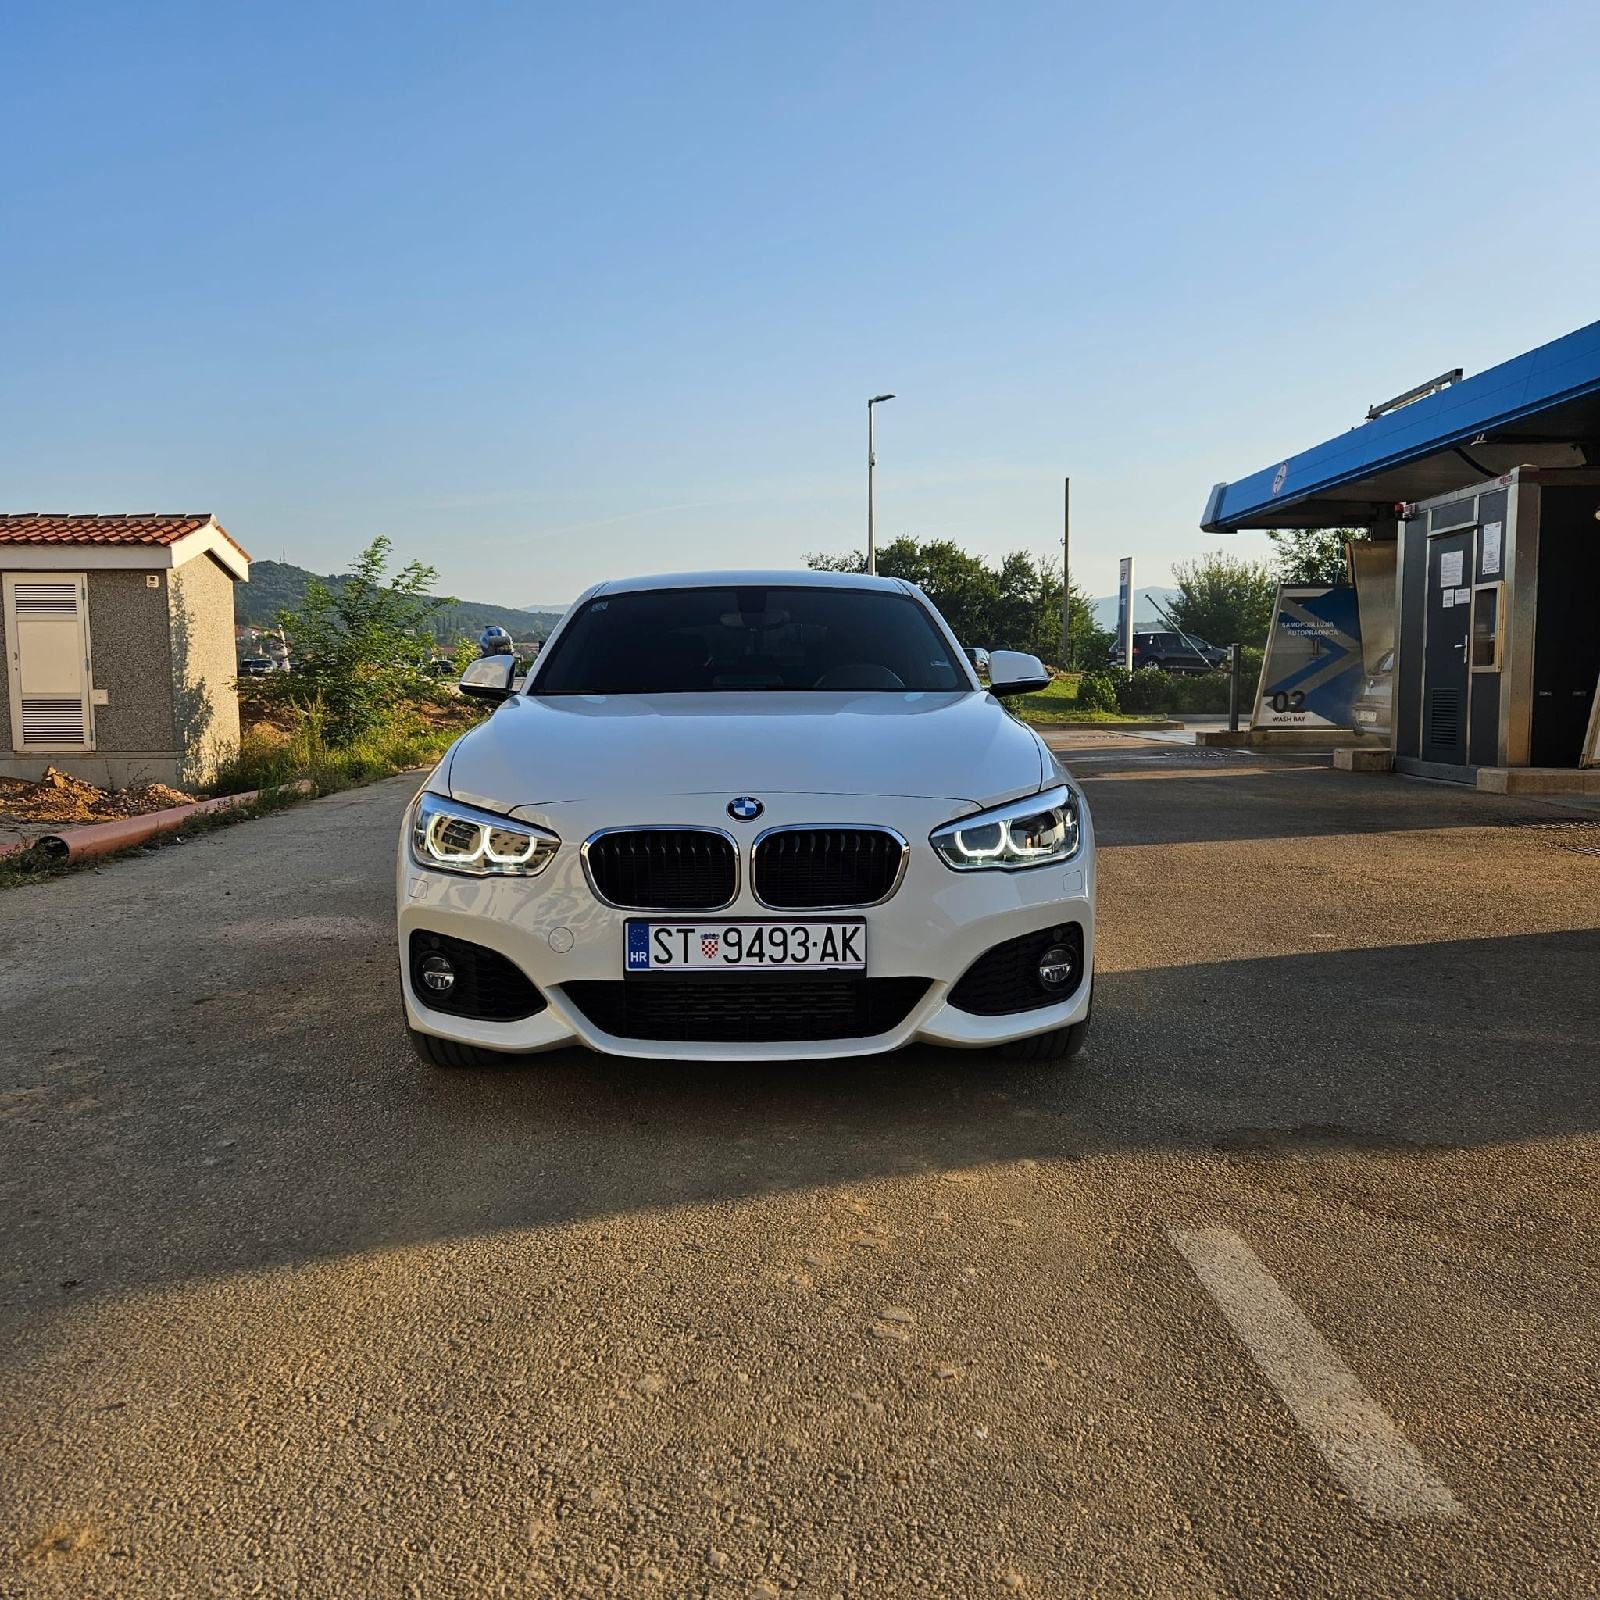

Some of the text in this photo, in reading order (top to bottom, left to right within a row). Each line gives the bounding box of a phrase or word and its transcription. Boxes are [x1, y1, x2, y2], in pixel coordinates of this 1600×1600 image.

[1272, 690, 1306, 714] 02
[630, 951, 647, 963] HR
[653, 927, 696, 965] ST
